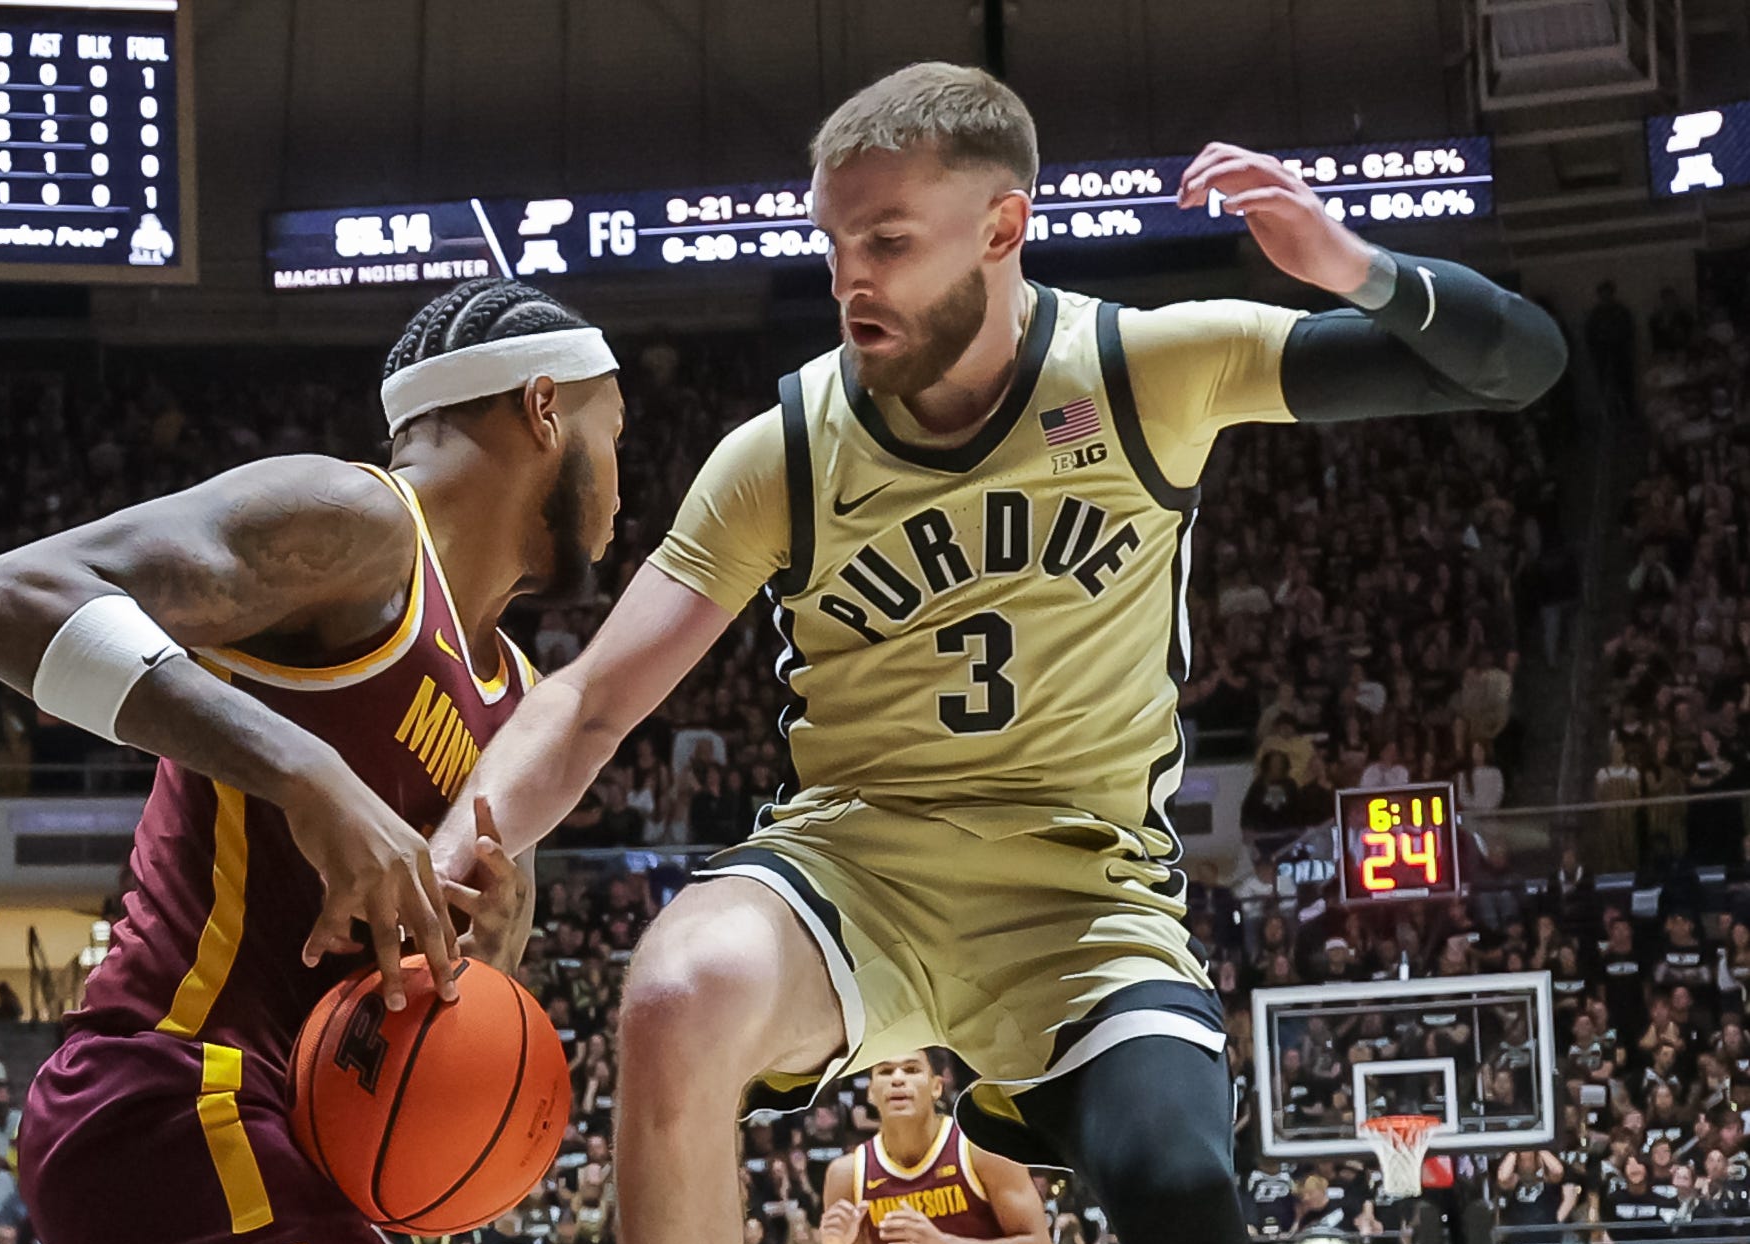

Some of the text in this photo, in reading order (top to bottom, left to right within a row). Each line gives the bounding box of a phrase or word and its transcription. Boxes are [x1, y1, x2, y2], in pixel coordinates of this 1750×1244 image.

[29, 33, 63, 58] AST
[39, 64, 57, 86] 0
[89, 66, 108, 88] 0
[142, 67, 155, 89] 1
[42, 94, 56, 115] 1
[89, 95, 108, 117] 0
[140, 96, 158, 118] 0
[40, 120, 59, 142] 2
[90, 122, 109, 144] 0
[140, 124, 159, 147] 0
[43, 152, 56, 175] 1
[91, 153, 109, 176] 0
[141, 155, 159, 178] 0
[1362, 148, 1465, 179] 62.5%
[41, 183, 60, 206] 0
[91, 185, 110, 208] 0
[144, 187, 157, 209] 1
[1059, 168, 1163, 198] 40.0%
[1370, 188, 1476, 220] 50.0%
[588, 210, 636, 257] FG
[274, 259, 489, 288] MACKEY NOISE METER
[817, 488, 1142, 646] PURDUE
[934, 610, 1017, 735] 3
[1368, 796, 1444, 832] 6:11
[1361, 830, 1437, 890] 24
